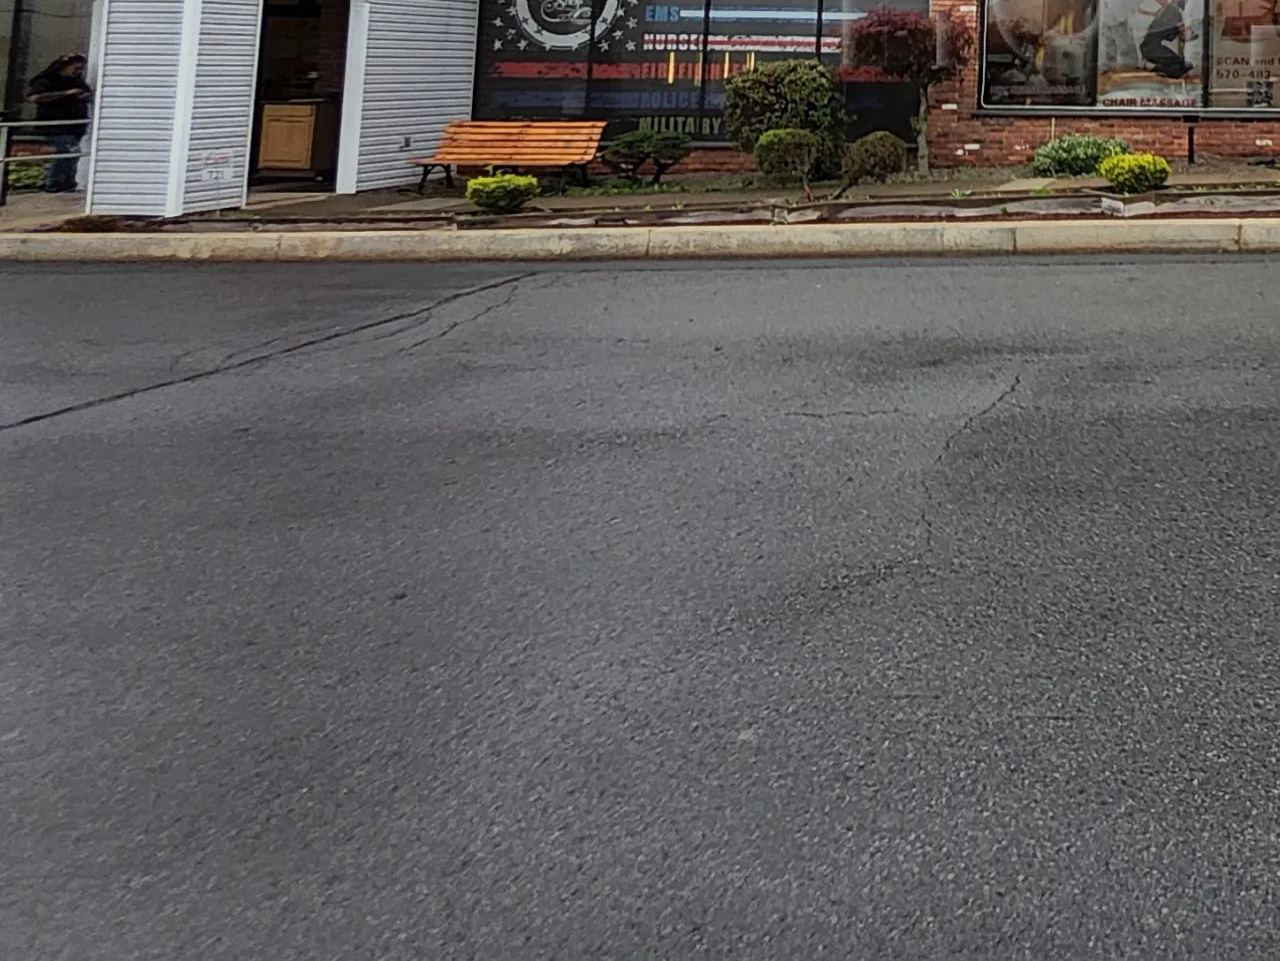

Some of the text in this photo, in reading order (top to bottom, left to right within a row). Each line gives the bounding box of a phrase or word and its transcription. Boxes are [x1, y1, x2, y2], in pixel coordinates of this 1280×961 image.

[645, 5, 679, 22] EMS
[643, 33, 700, 51] NURSE
[1216, 56, 1249, 66] SCAN
[641, 92, 698, 110] POLICE
[1102, 98, 1197, 107] CHAIR MASSAGE
[639, 116, 722, 135] MILITARY
